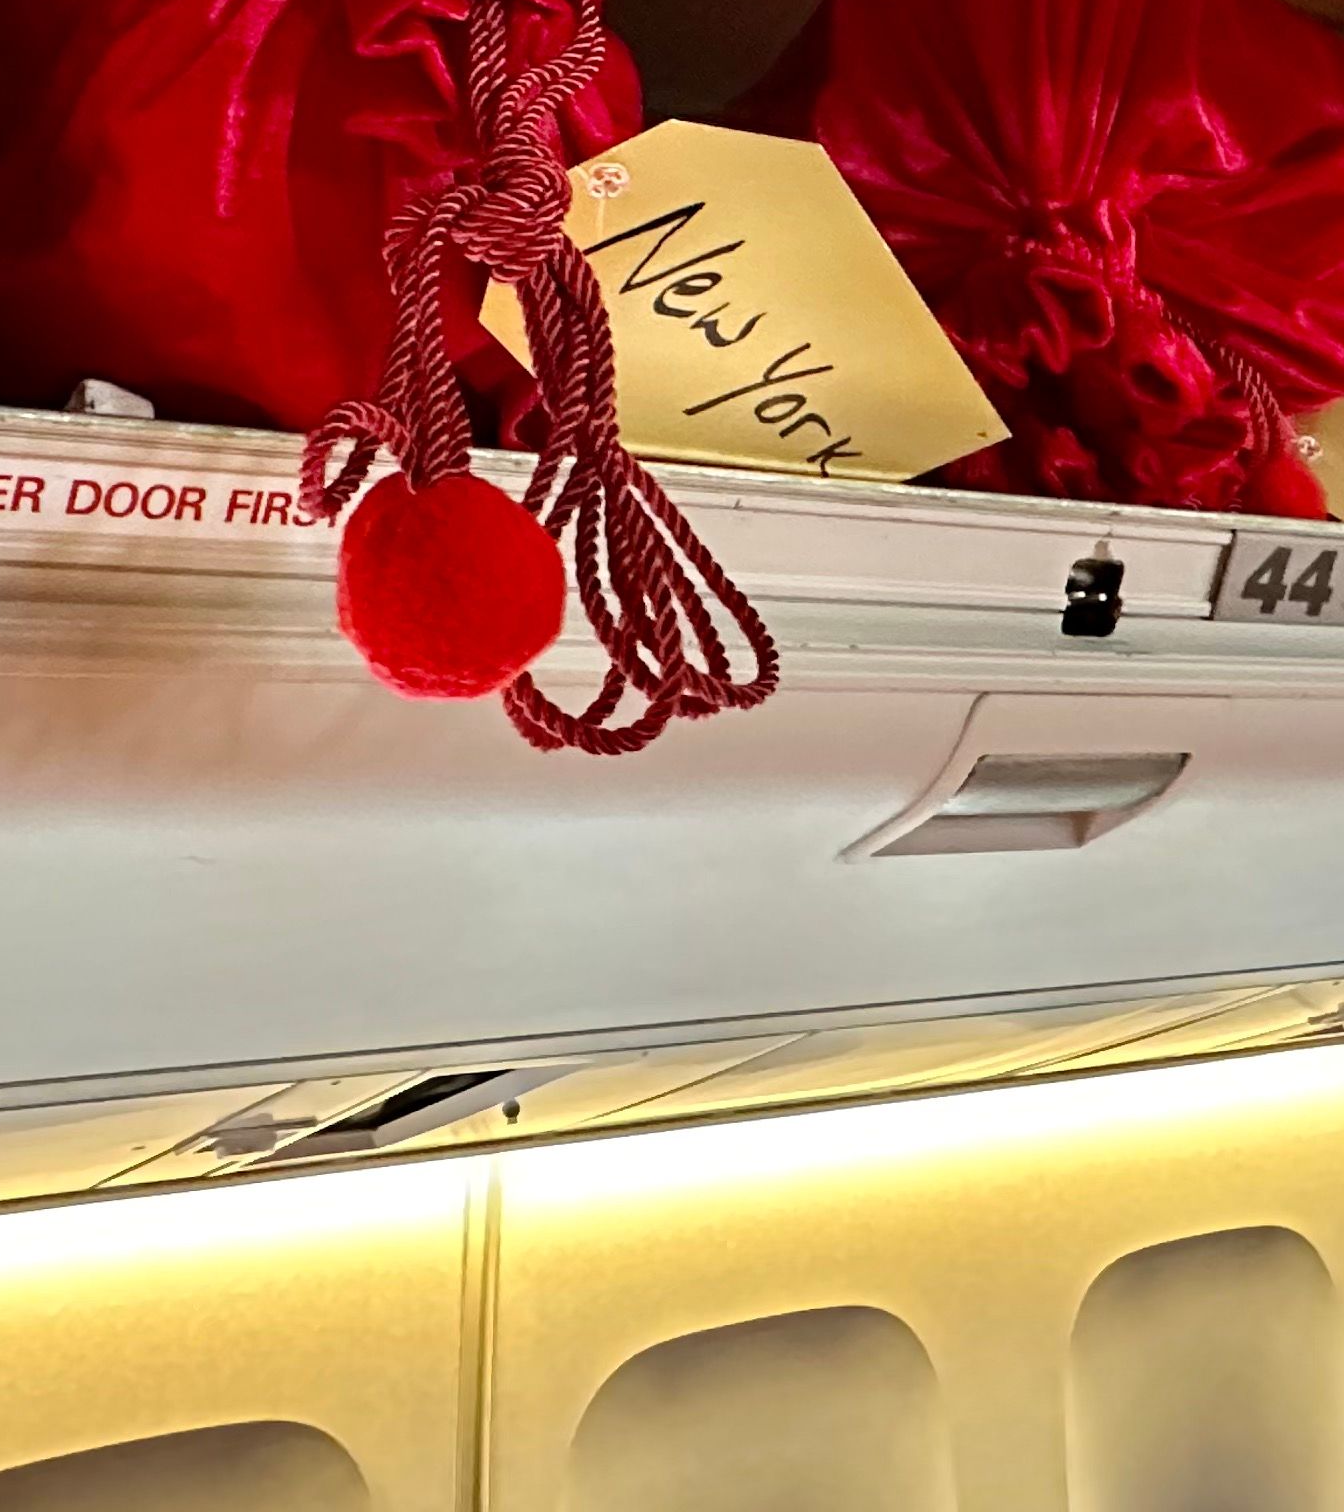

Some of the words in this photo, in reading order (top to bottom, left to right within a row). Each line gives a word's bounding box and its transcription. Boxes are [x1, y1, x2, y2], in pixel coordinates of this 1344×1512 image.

[582, 201, 768, 348] New
[682, 342, 864, 478] York
[65, 479, 207, 522] DOOR
[1240, 545, 1338, 617] 44
